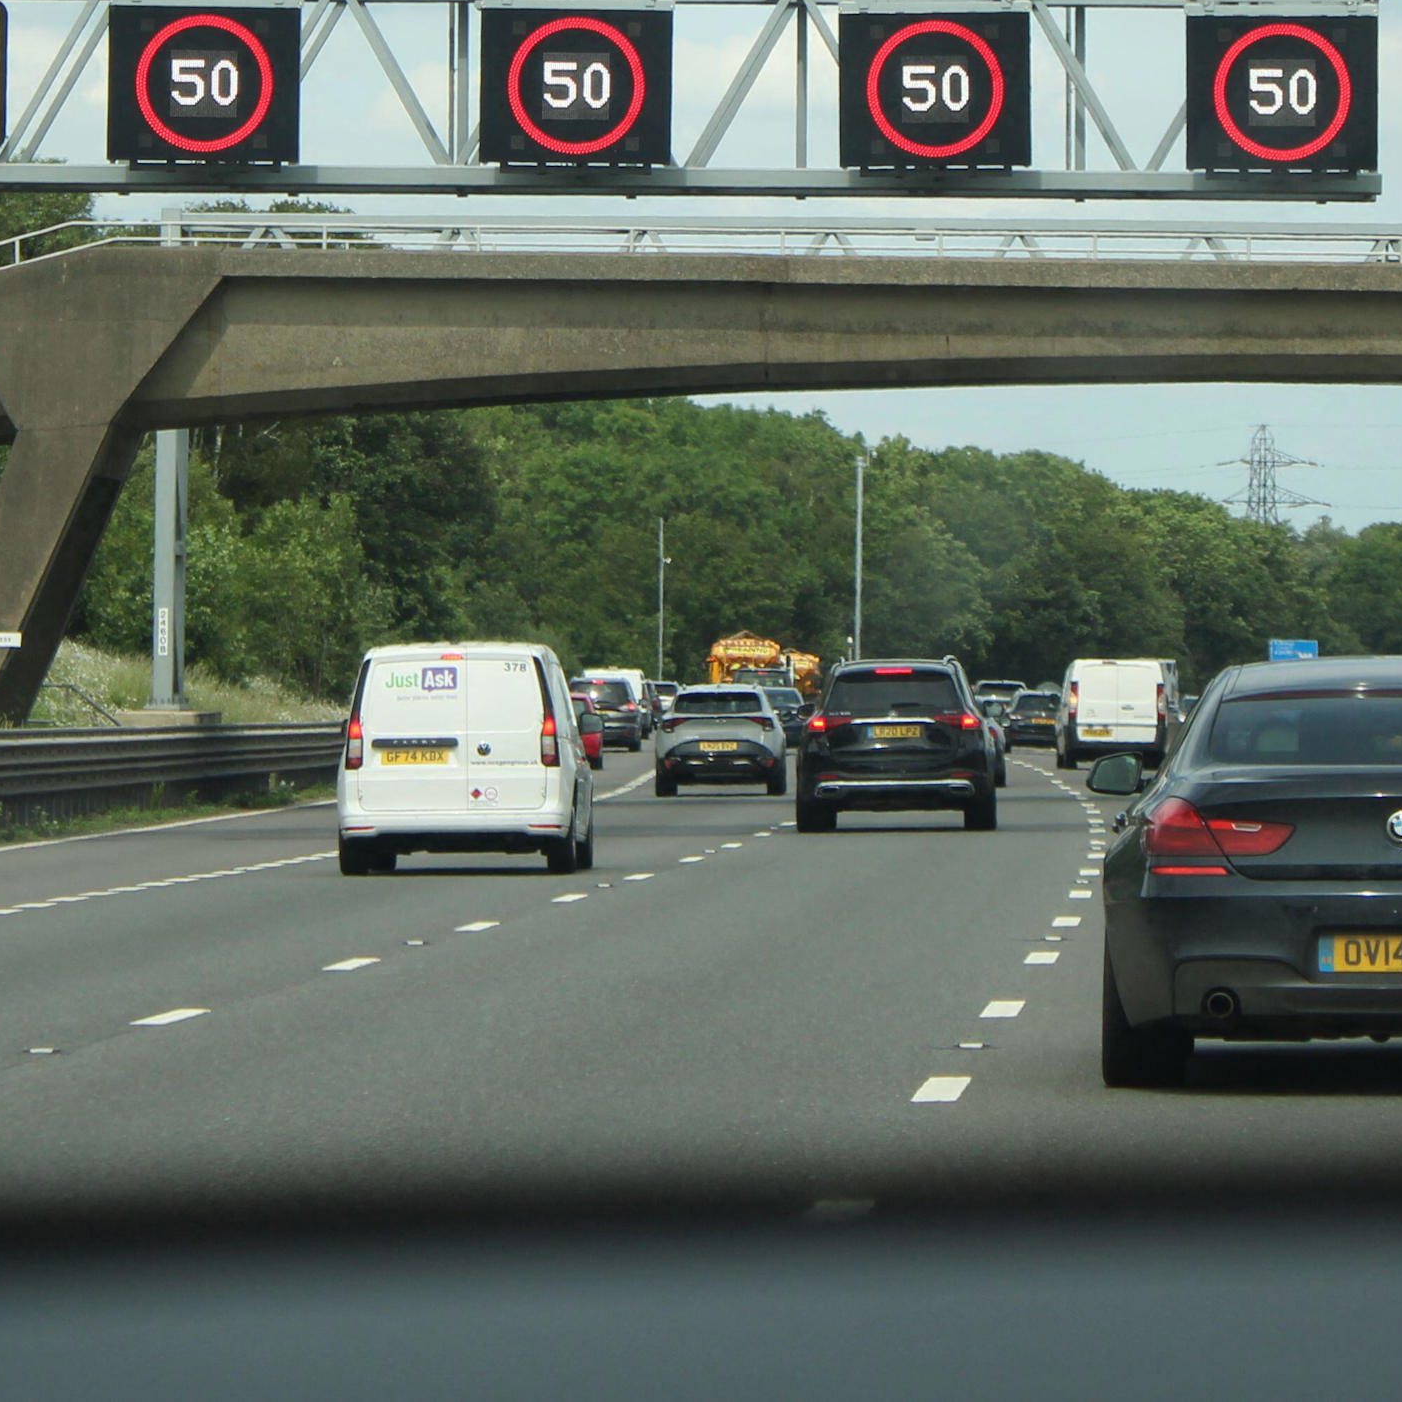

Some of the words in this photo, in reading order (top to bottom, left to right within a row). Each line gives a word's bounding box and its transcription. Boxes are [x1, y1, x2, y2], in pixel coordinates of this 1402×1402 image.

[171, 58, 239, 107] 50
[542, 61, 611, 110] 50
[901, 63, 970, 113] 50
[1249, 67, 1317, 116] 50
[385, 672, 419, 689] Just
[423, 669, 455, 688] Ask
[504, 662, 528, 672] 378
